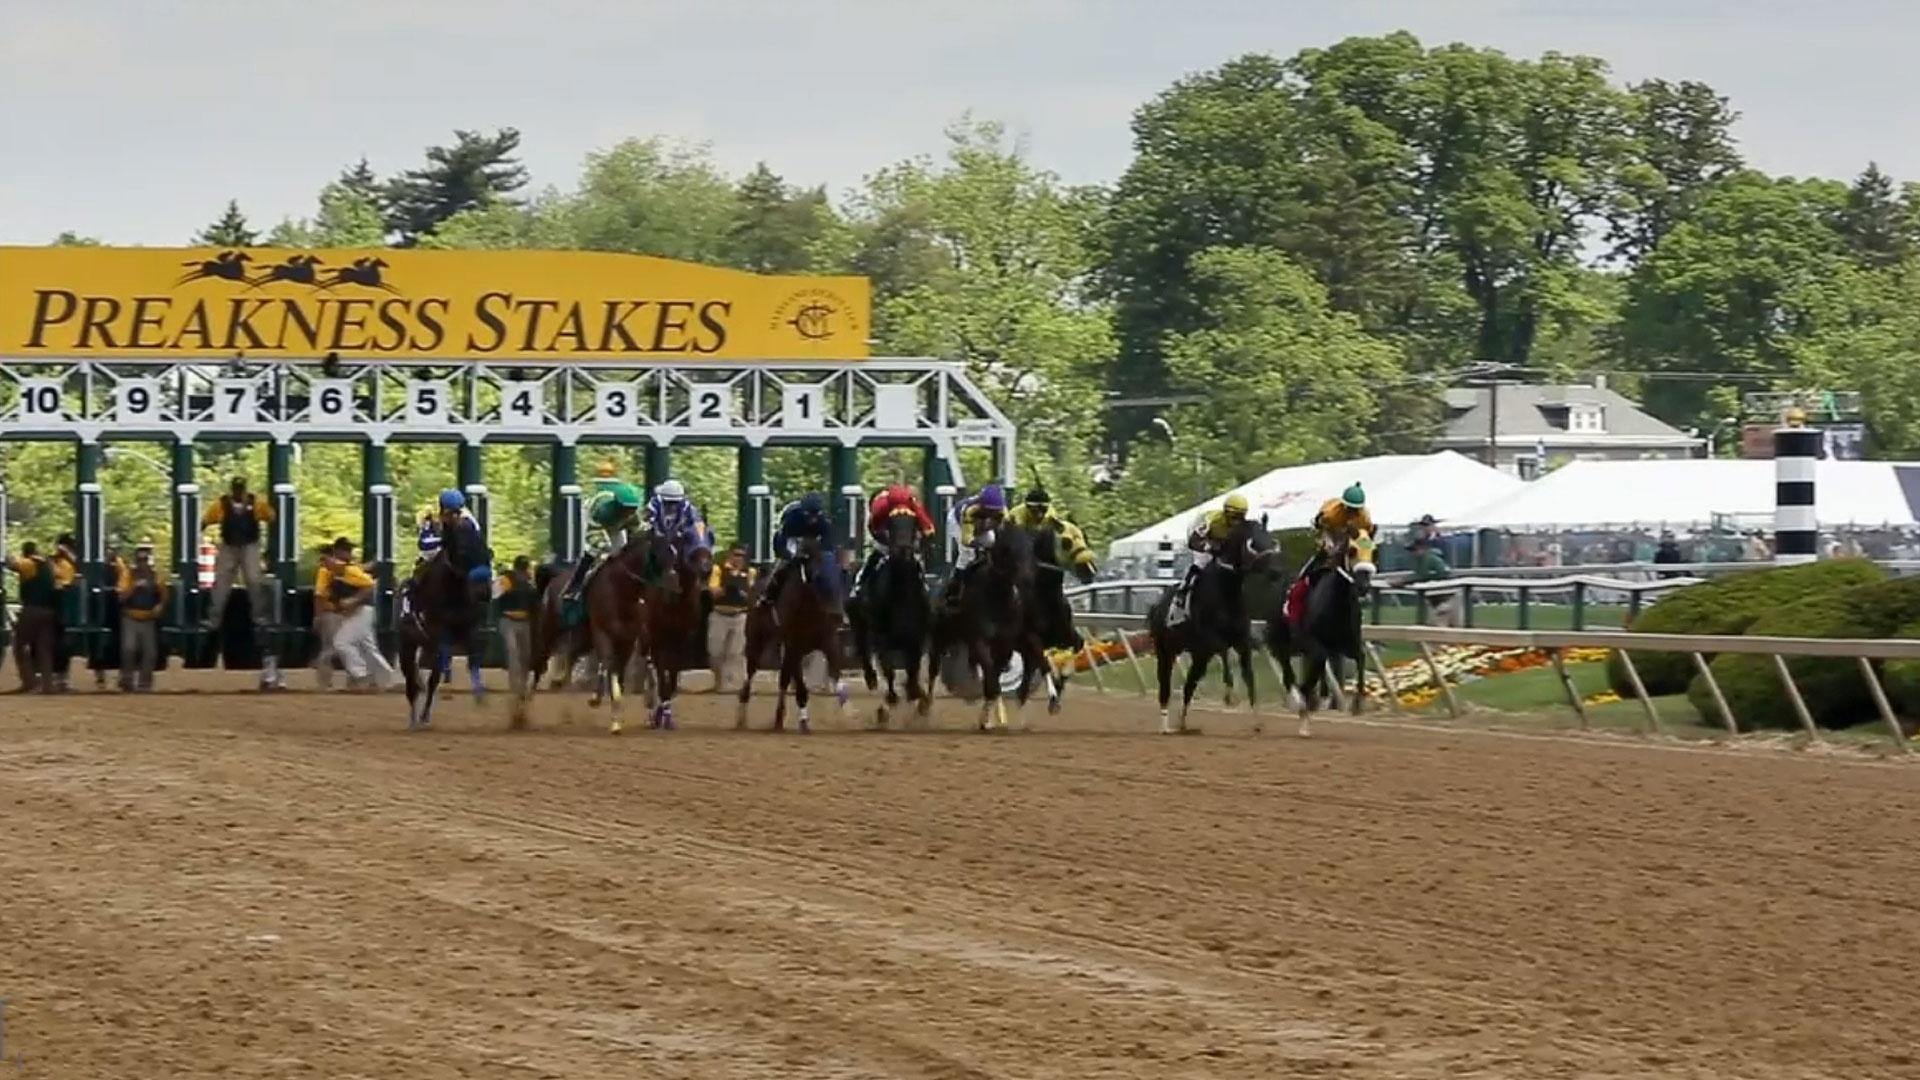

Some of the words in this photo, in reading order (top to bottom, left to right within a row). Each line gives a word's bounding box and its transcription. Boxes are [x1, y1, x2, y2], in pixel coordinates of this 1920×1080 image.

[22, 290, 449, 352] PREAKNESS
[467, 292, 732, 354] STAKES
[21, 387, 59, 413] 10
[128, 387, 150, 414] 9
[225, 388, 246, 414] 7
[320, 388, 342, 414] 6
[416, 389, 438, 415] 5
[511, 391, 534, 417] 4
[606, 391, 627, 417] 3
[700, 393, 721, 418] 2
[797, 393, 810, 418] 1
